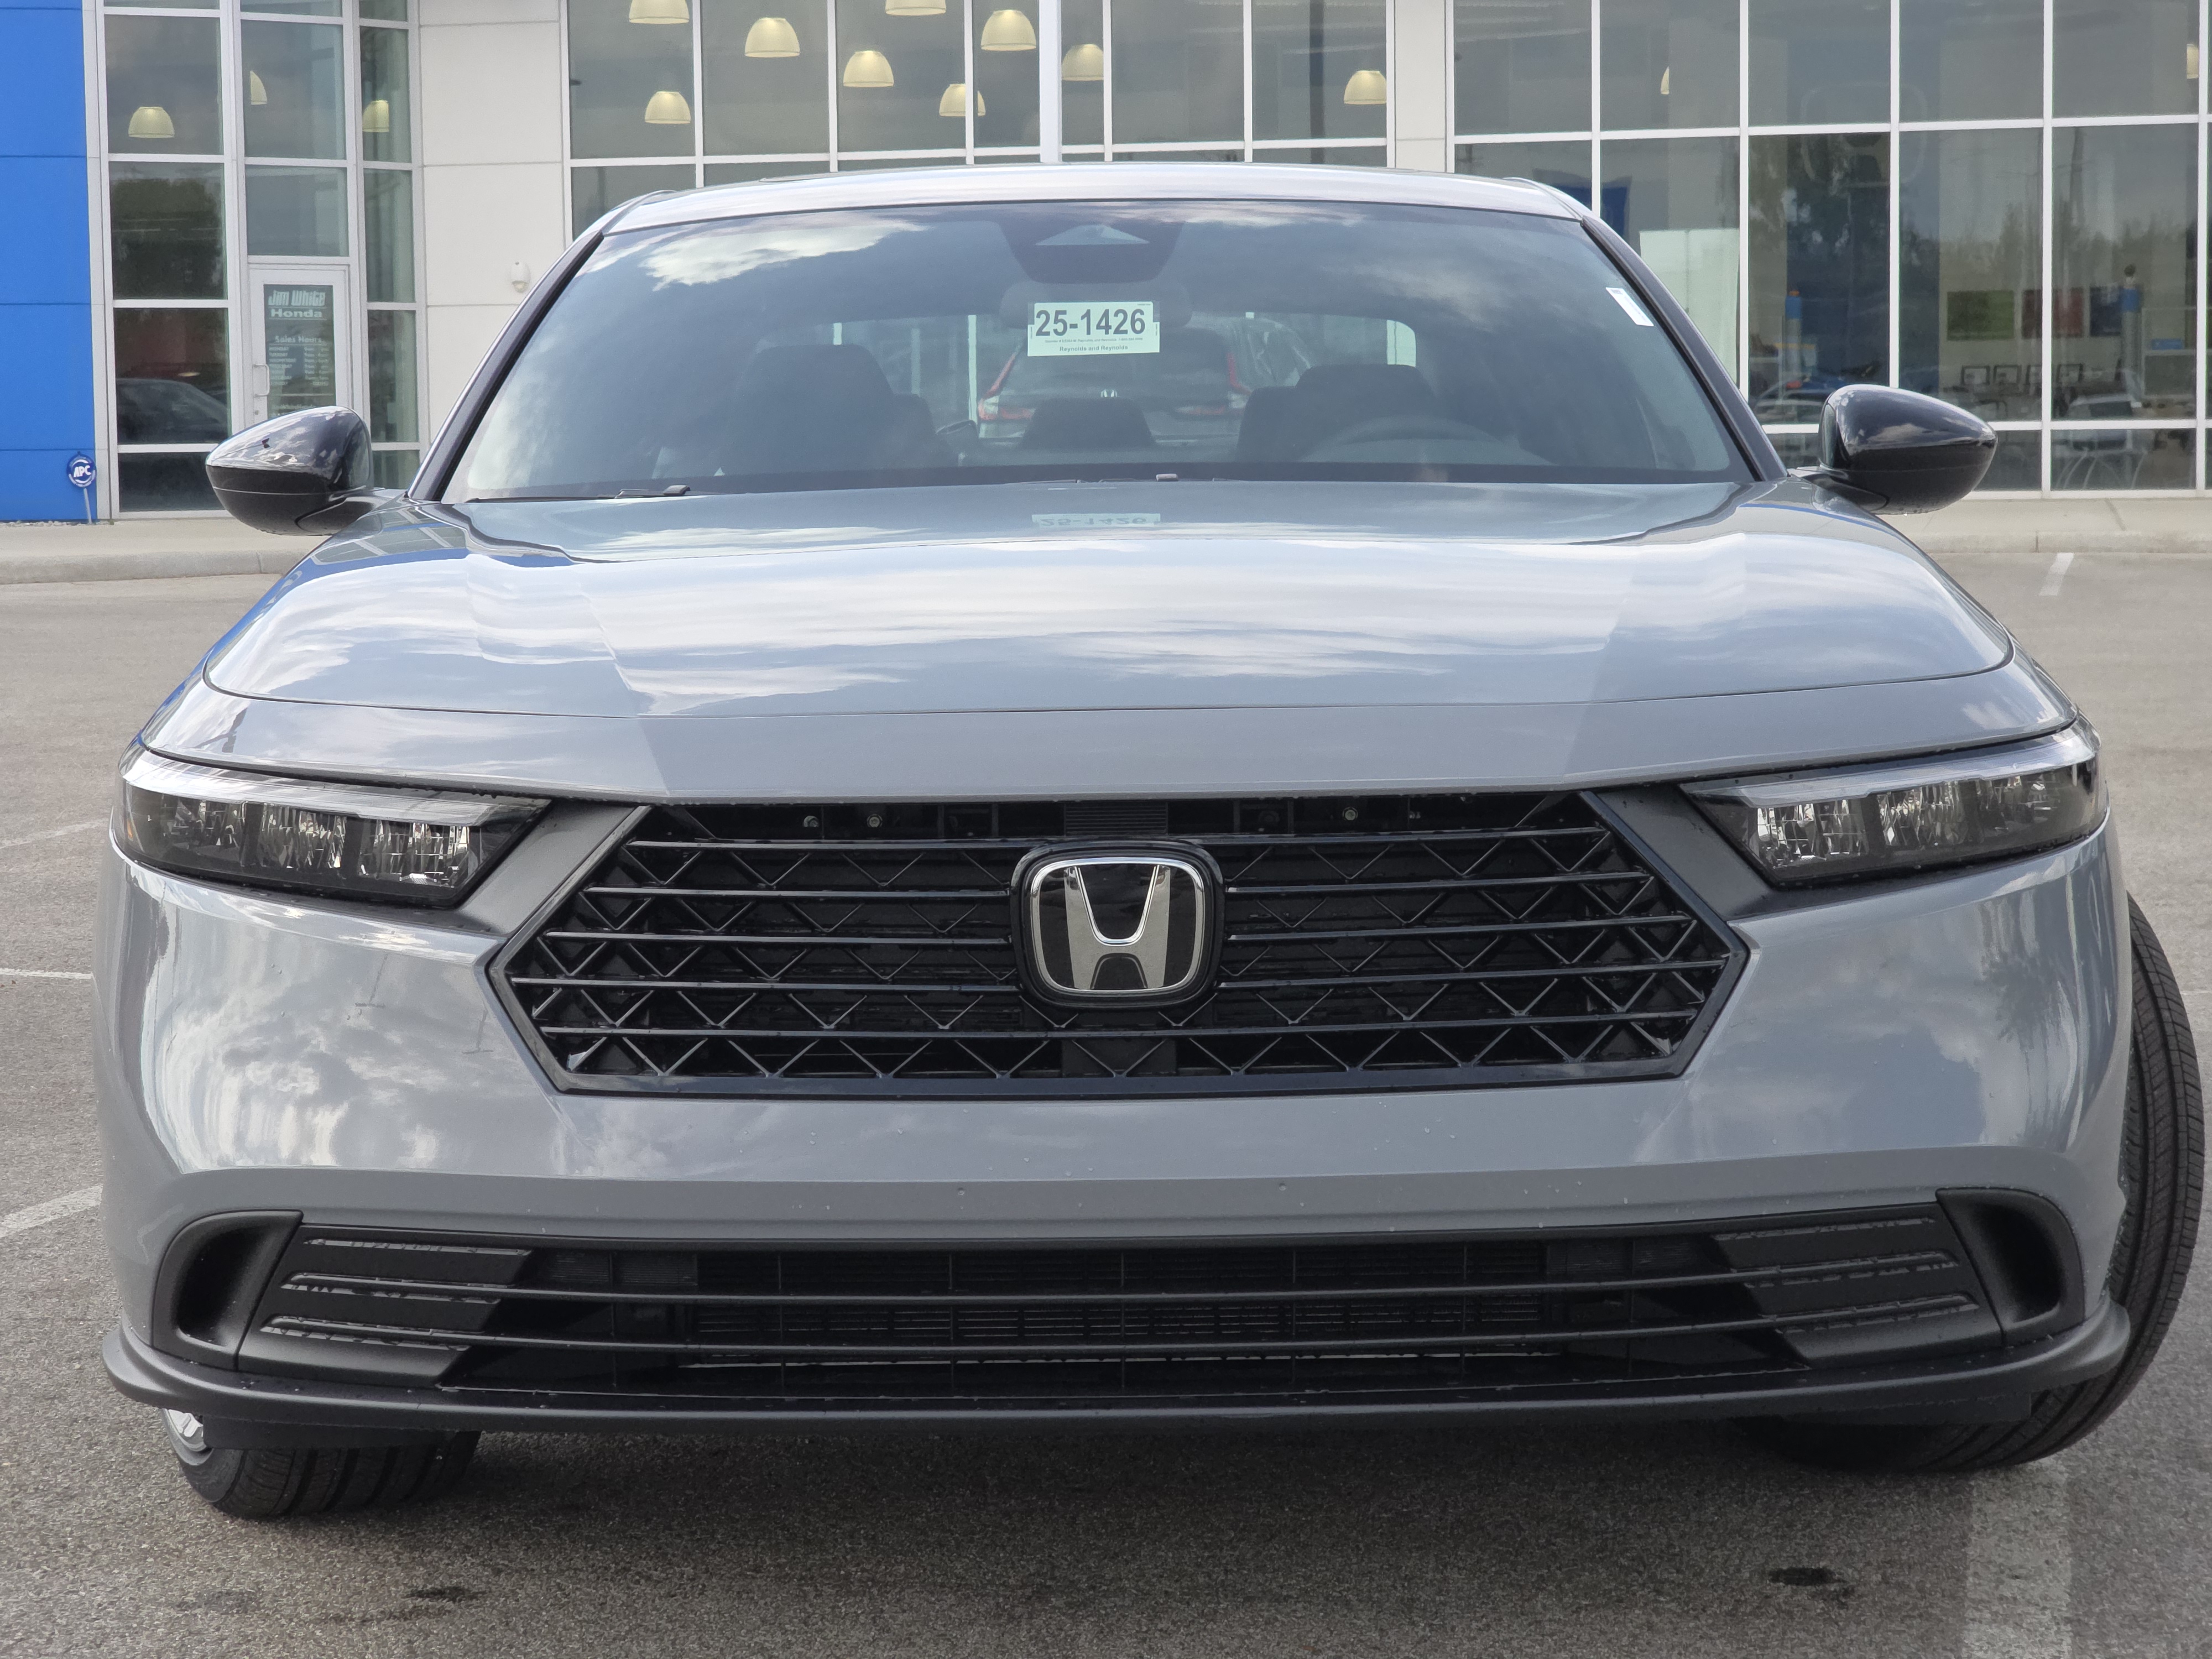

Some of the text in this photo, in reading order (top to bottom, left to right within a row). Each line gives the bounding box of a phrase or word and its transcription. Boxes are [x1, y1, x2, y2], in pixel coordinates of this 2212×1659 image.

[268, 290, 326, 306] Jim White
[270, 308, 322, 318] Honda
[1035, 309, 1145, 336] 25-1426
[74, 465, 92, 477] APC
